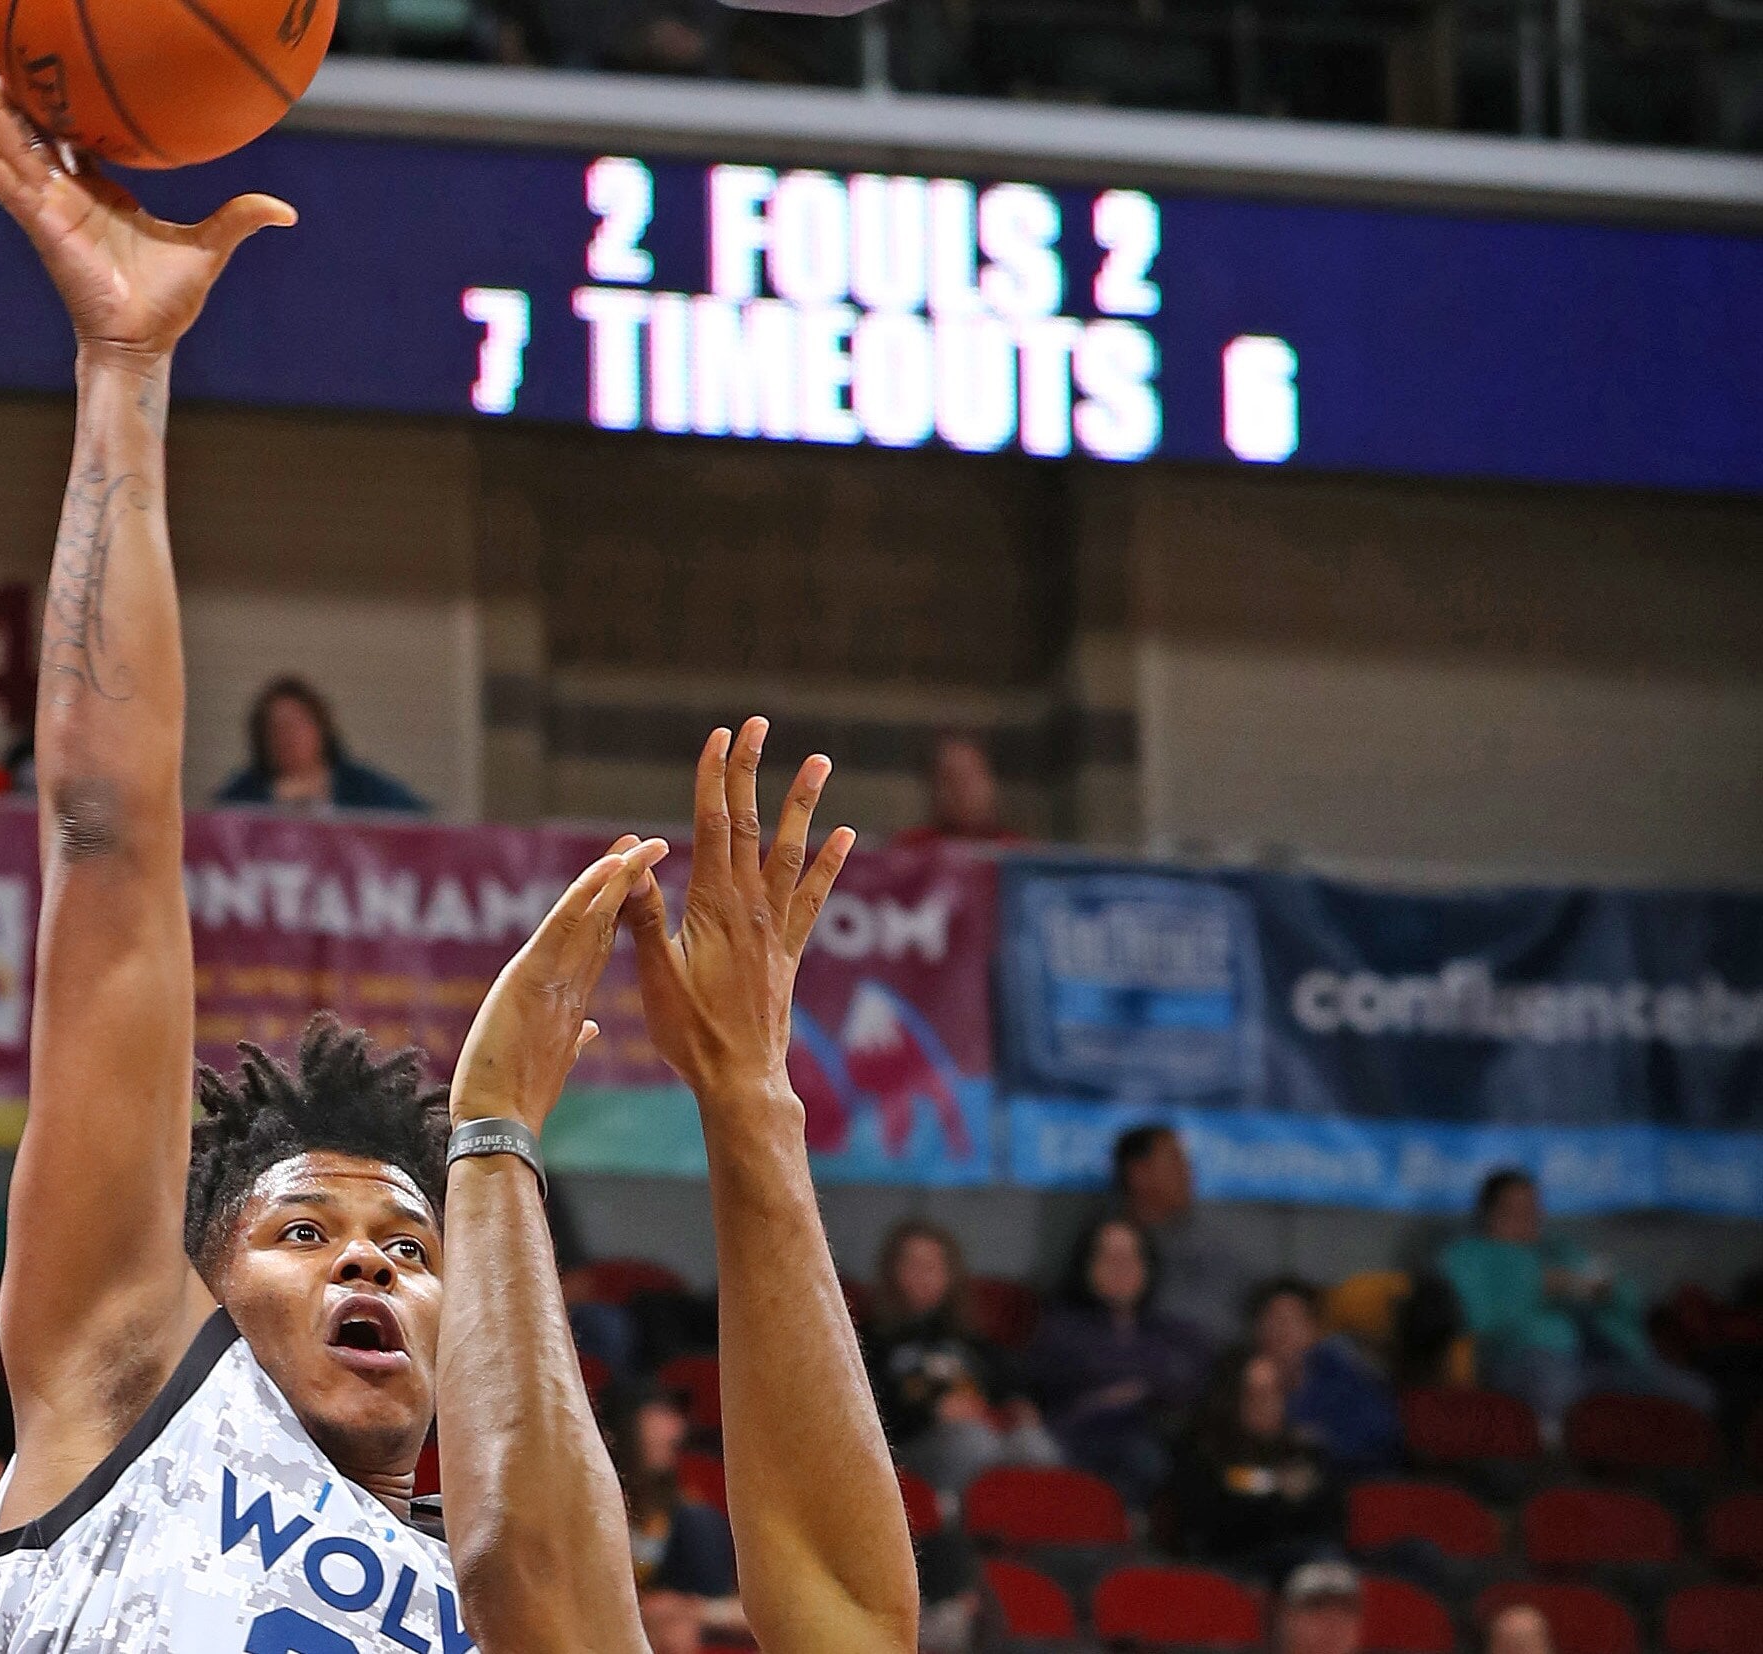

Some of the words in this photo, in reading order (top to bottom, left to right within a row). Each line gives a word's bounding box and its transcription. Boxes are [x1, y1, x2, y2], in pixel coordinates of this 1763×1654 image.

[585, 156, 654, 283] 2
[708, 163, 1062, 318] FOULS
[1092, 189, 1160, 316] 2
[462, 287, 530, 414] 7
[571, 286, 1162, 462] TIMEOUTS
[1222, 335, 1299, 463] 6
